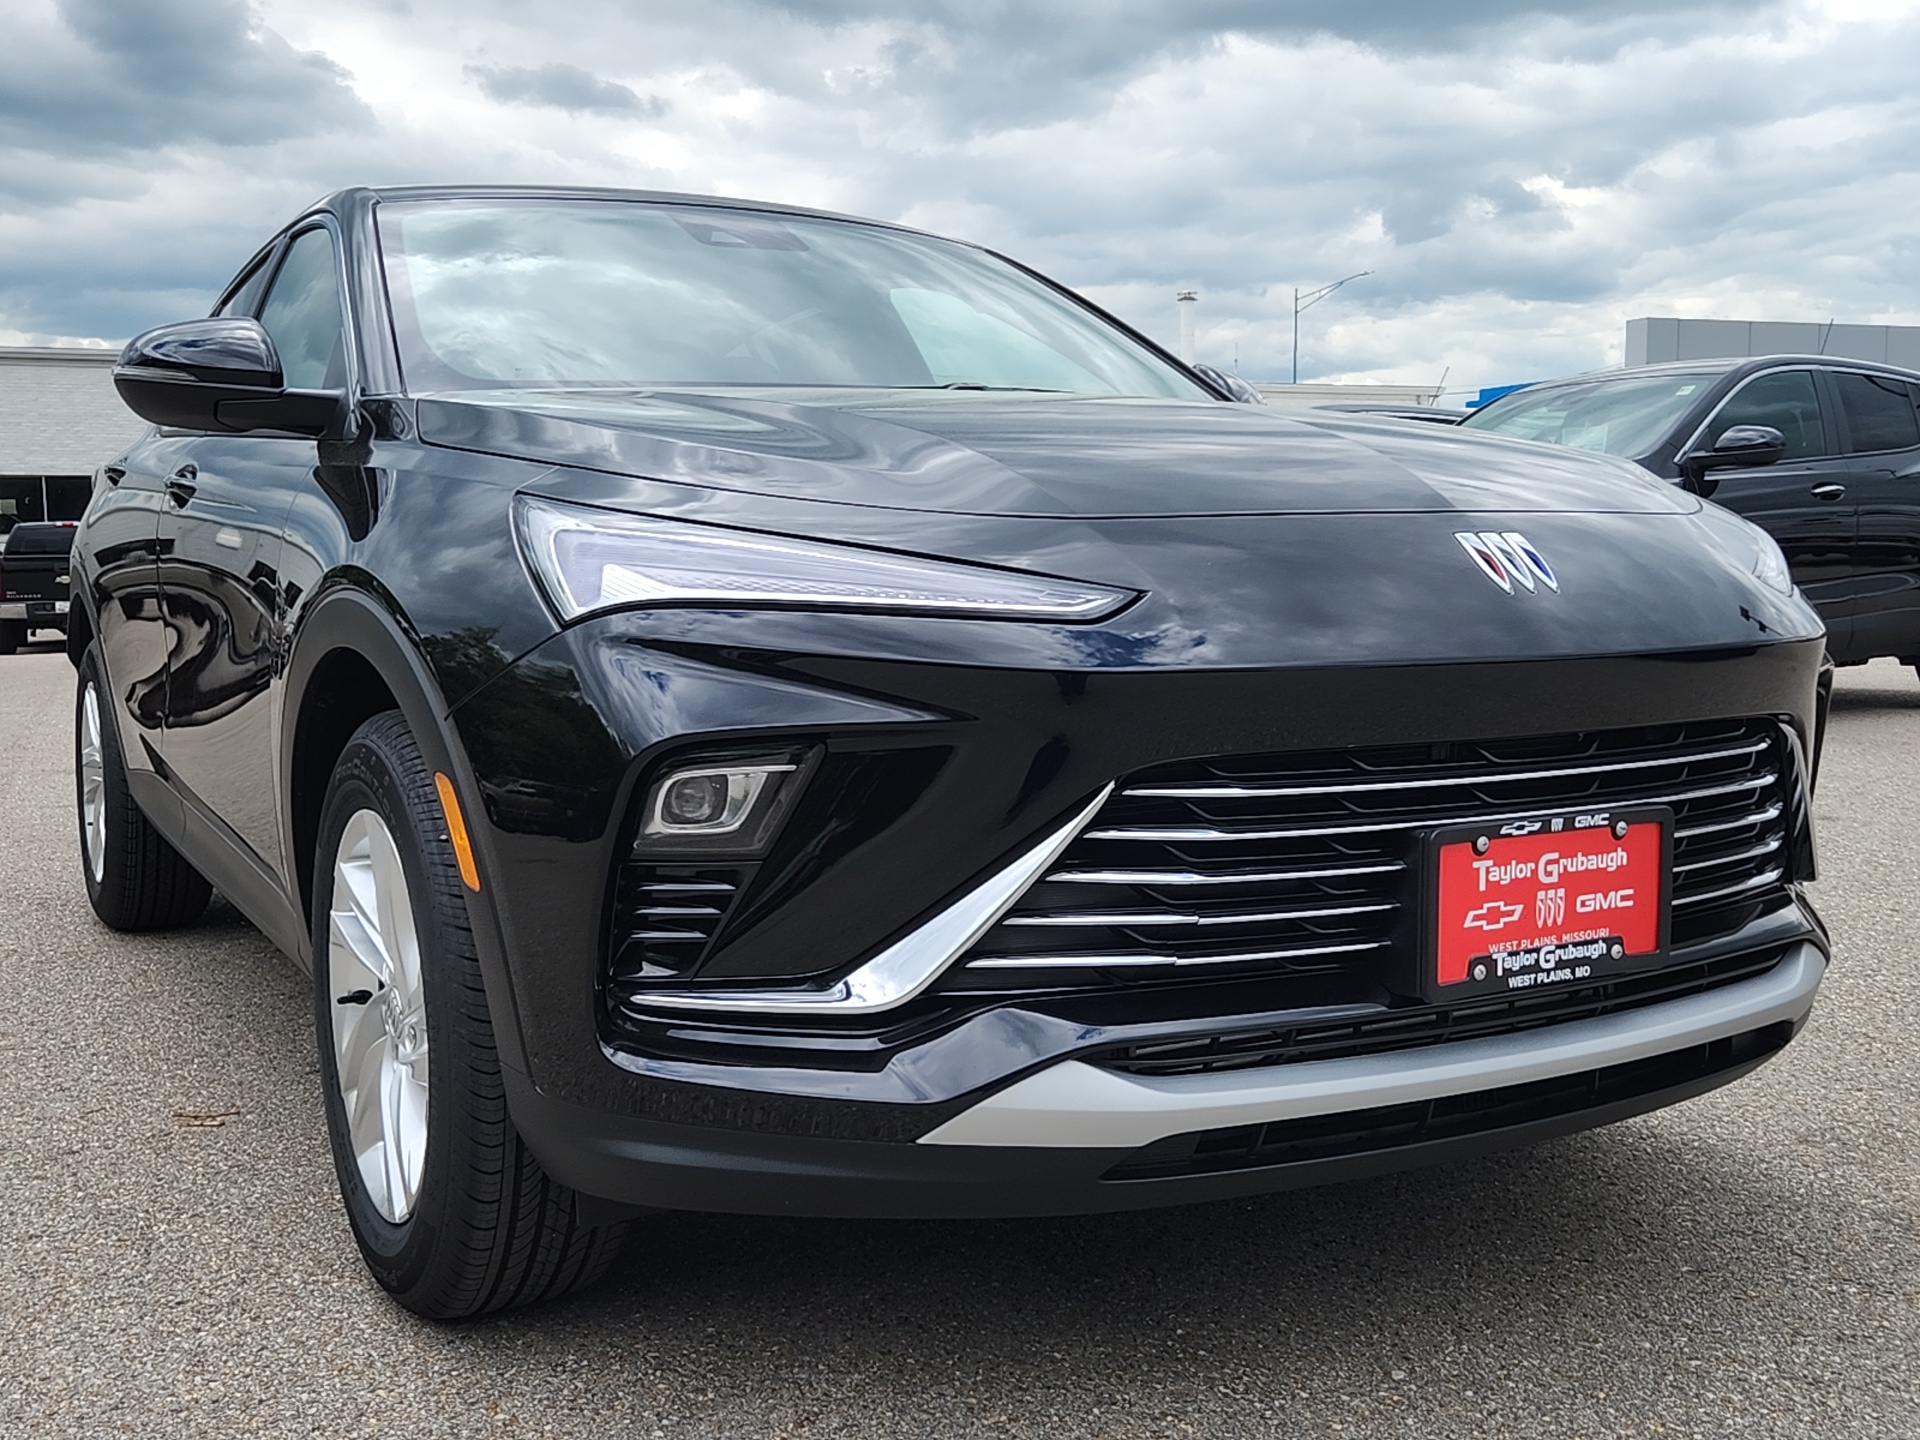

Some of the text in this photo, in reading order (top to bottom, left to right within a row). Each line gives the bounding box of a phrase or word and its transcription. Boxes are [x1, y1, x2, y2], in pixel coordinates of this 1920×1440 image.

[1575, 814, 1609, 829] GMC
[1472, 848, 1627, 891] Taylor Grubaugh
[1576, 889, 1634, 913] GMC
[1489, 943, 1518, 954] WEST
[1562, 928, 1609, 942] MISSOURI
[1492, 940, 1607, 976] Taylor Grubaugh
[1508, 966, 1590, 988] WEST PLAINS, MO
